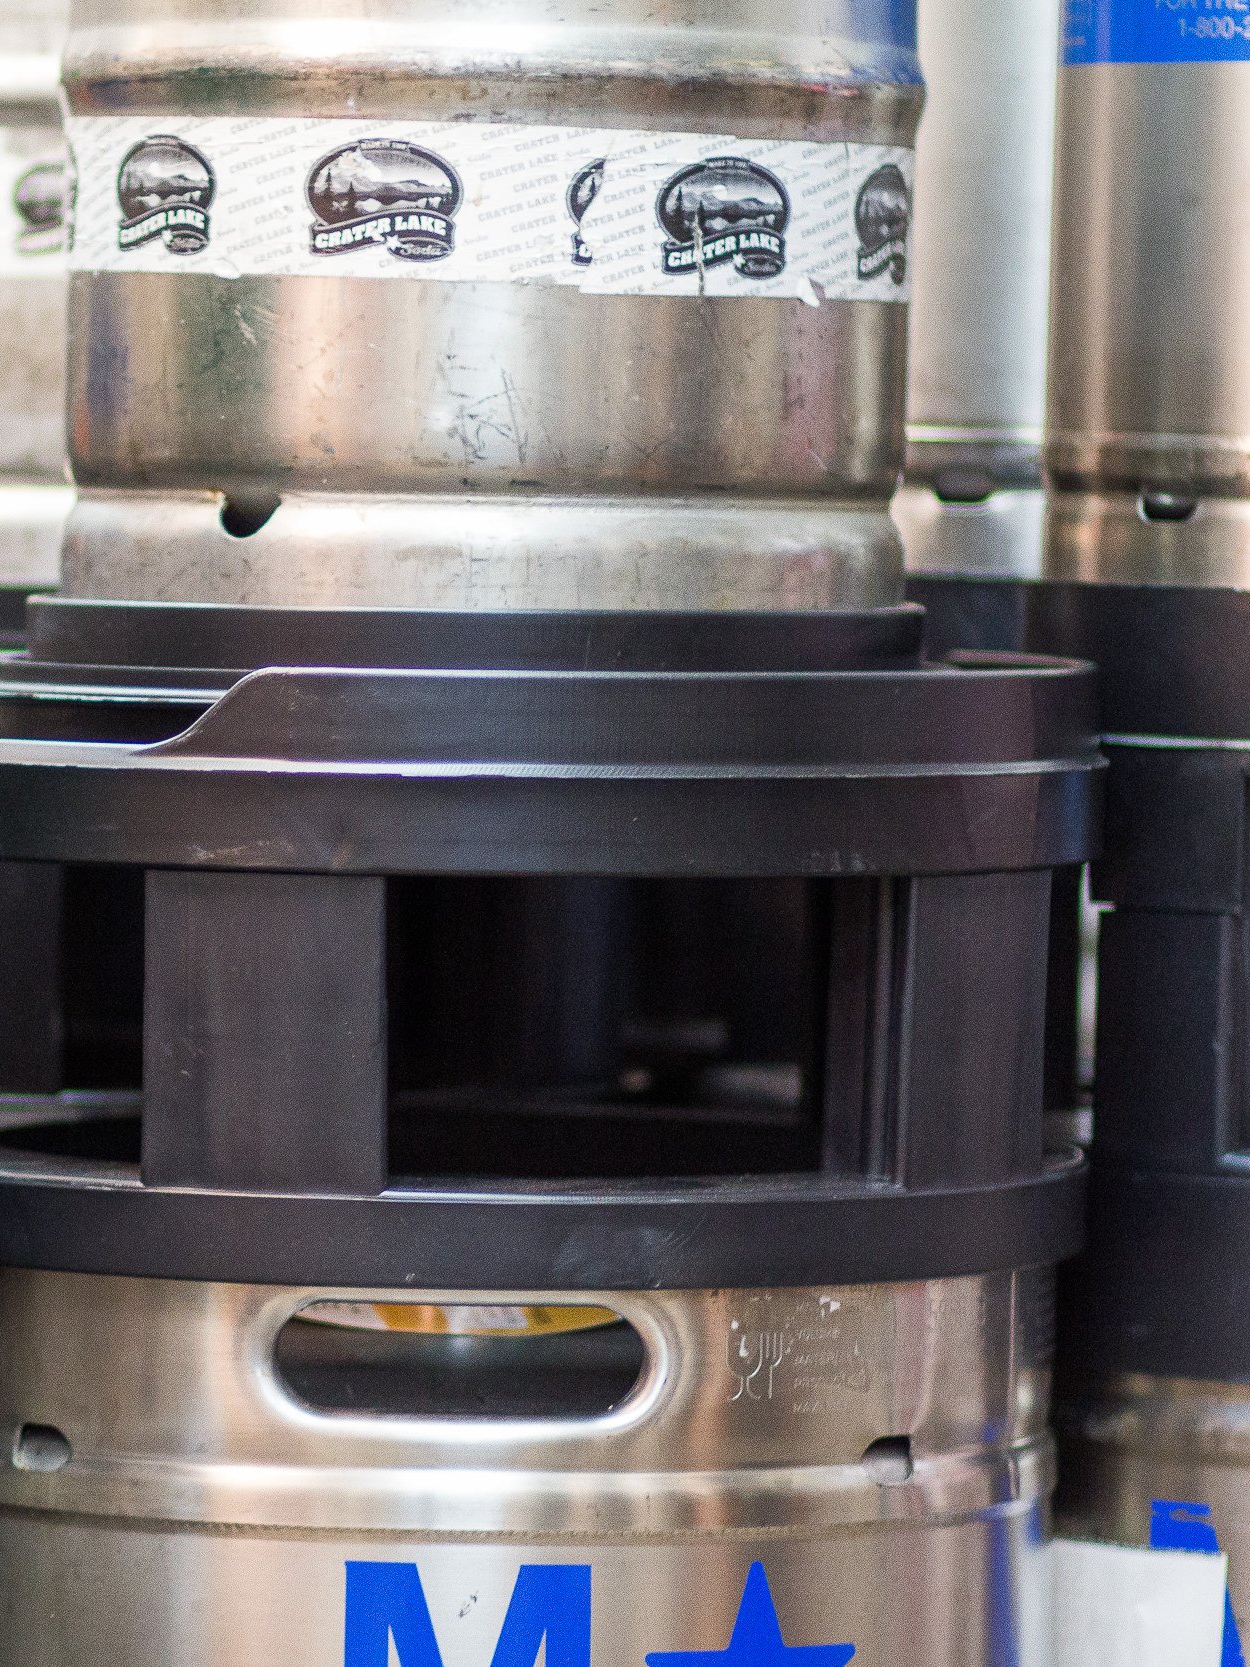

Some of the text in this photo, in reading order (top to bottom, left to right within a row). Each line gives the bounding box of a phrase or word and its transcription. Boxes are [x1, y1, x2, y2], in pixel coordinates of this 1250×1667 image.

[168, 209, 205, 230] LAKE
[315, 215, 446, 249] CRATER LAKE
[667, 236, 737, 267] CRATER
[739, 233, 779, 253] LAKE
